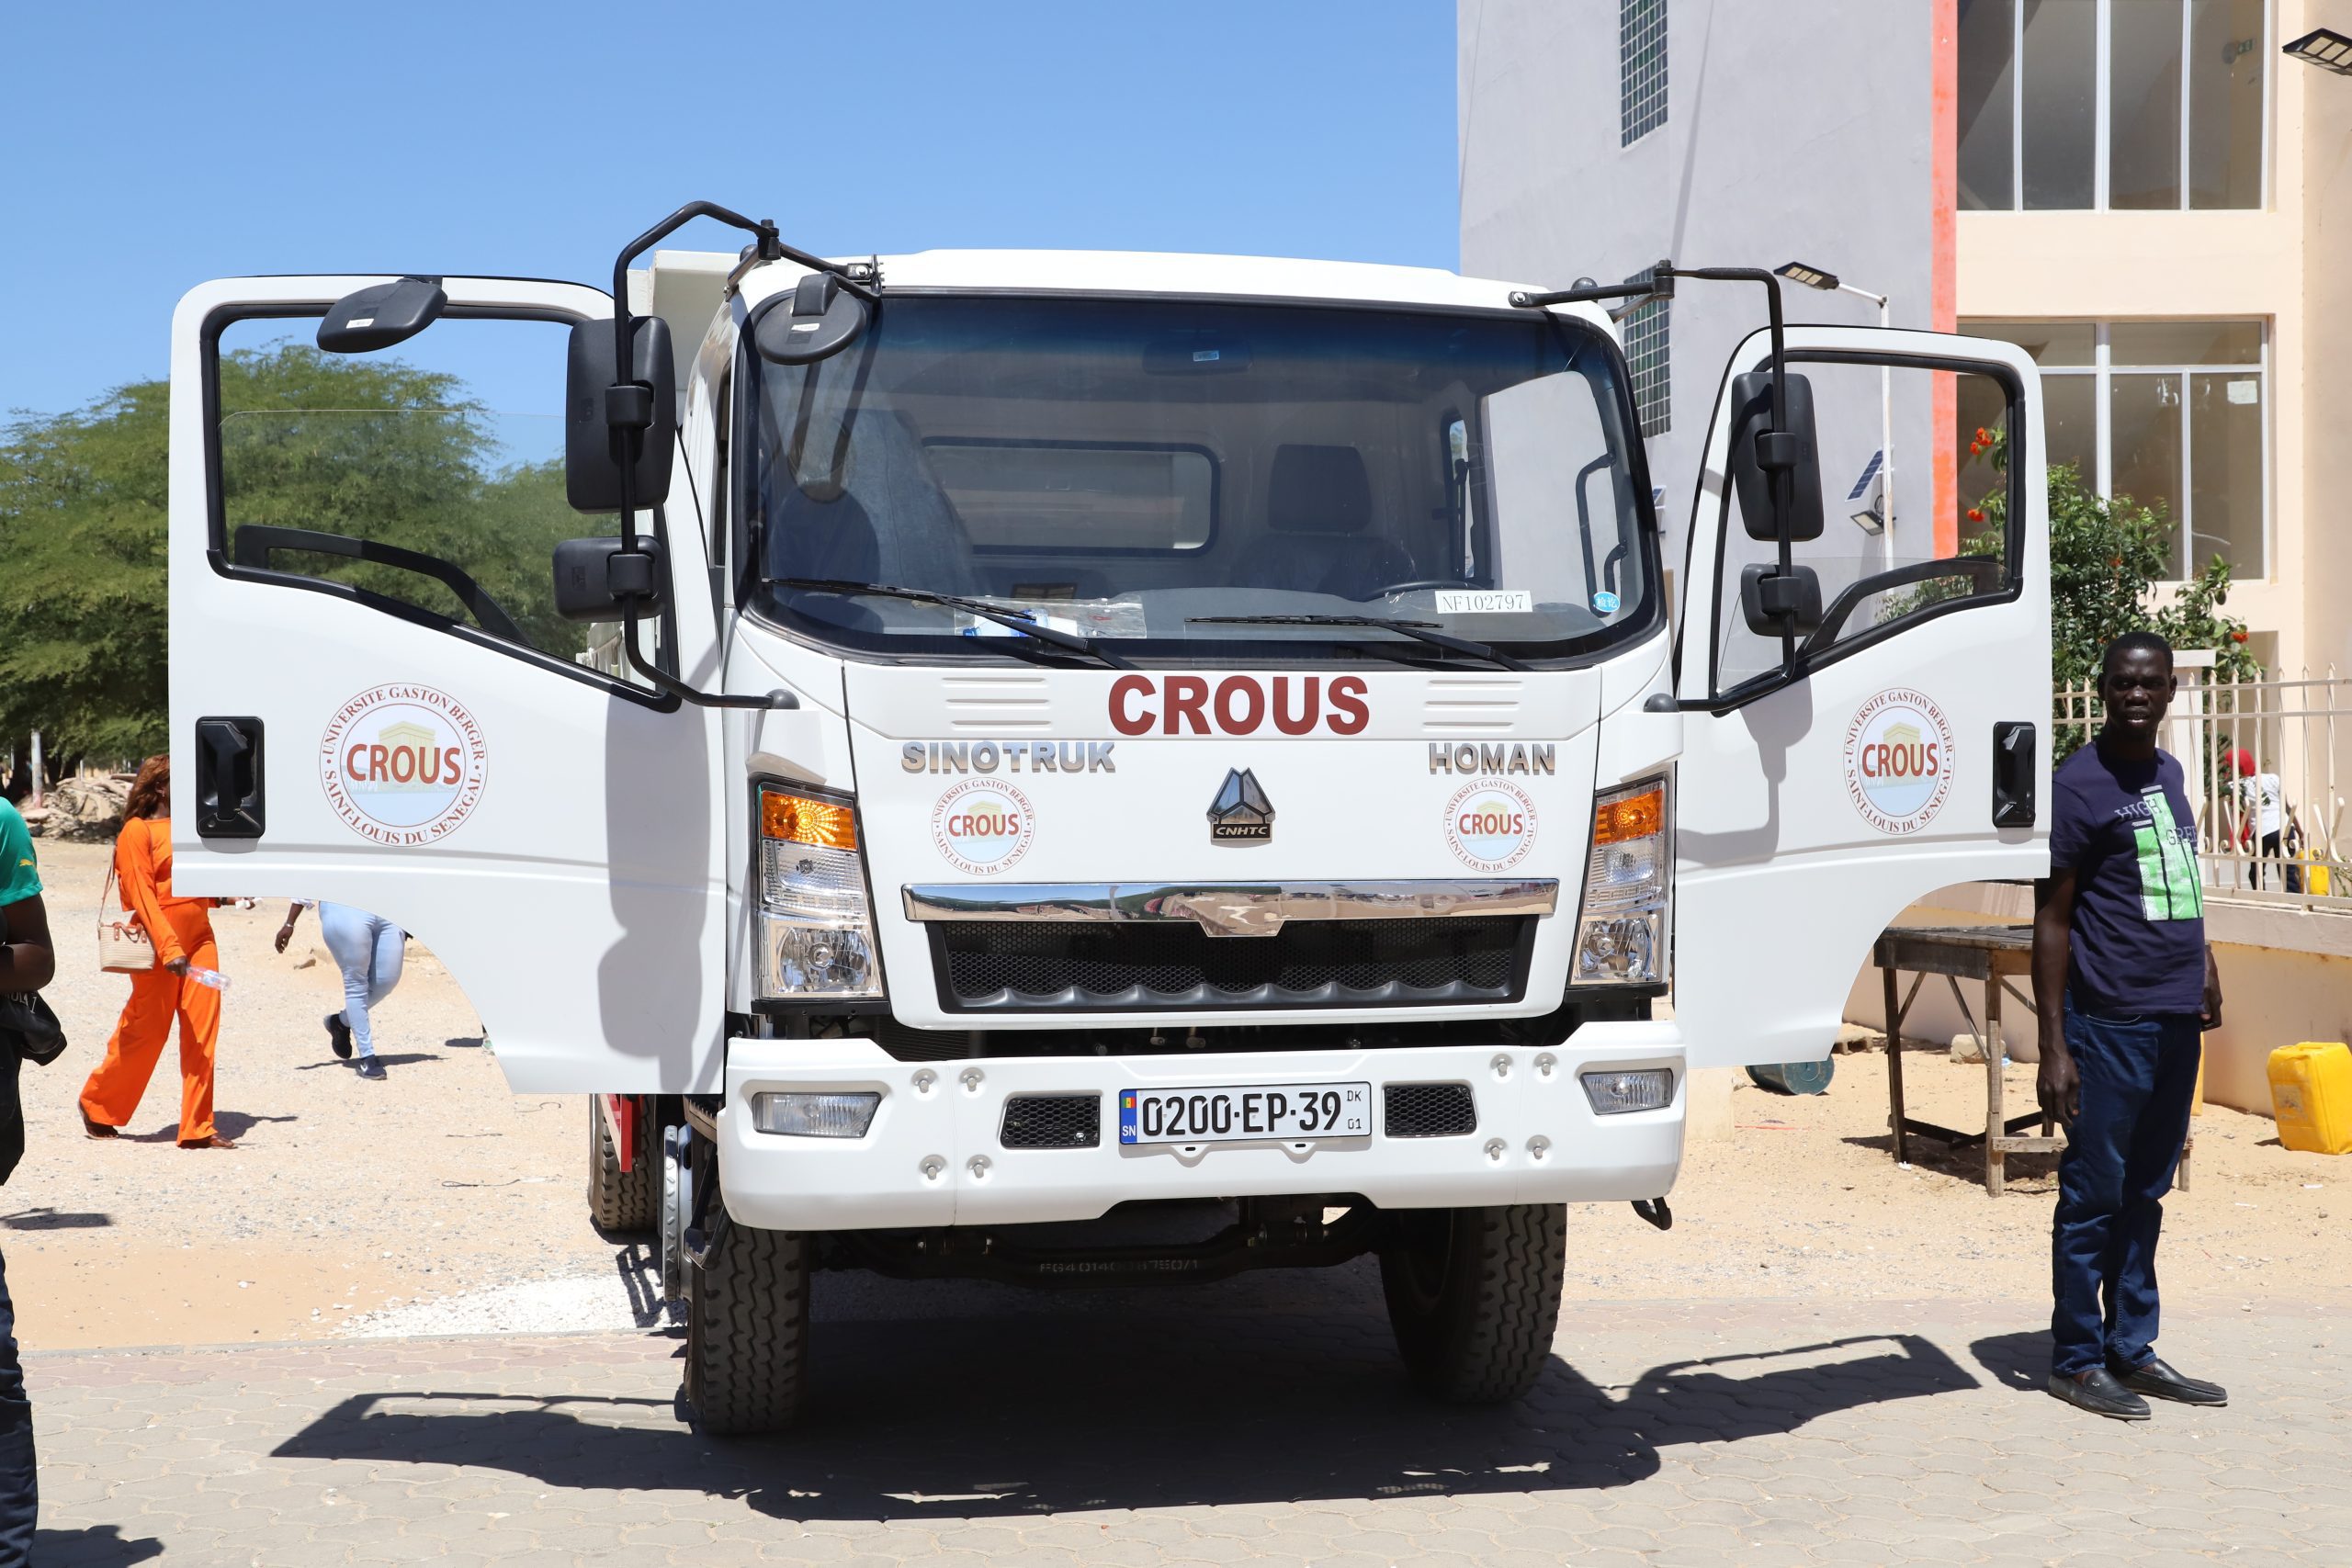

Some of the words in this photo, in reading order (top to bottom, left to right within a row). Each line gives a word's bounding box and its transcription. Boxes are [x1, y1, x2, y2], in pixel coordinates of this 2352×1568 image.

[1442, 593, 1524, 612] NF102797
[322, 688, 386, 755] UNIVERSITE
[389, 686, 450, 710] GASTON
[447, 705, 485, 761] BERGER
[1108, 674, 1370, 736] CROUS
[1845, 694, 1887, 756] UNIVERSITE
[1888, 691, 1929, 710] GASTON
[1928, 705, 1955, 754] BERGER
[346, 743, 461, 784] CROUS
[901, 740, 1116, 773] SINOTRUK
[1429, 742, 1555, 774] HOMAN
[1861, 743, 1939, 778] CROUS
[324, 770, 401, 845] SAINT-LOUIS
[404, 829, 429, 845] DU
[430, 773, 481, 839] SENEGAL
[933, 781, 971, 824] UNIVERSITE
[972, 779, 1010, 792] GASTON
[1010, 788, 1034, 821] BERGER
[1445, 782, 1481, 822] UNIVERSITE
[1481, 780, 1515, 793] GASTON
[1514, 789, 1536, 821] BERGER
[1847, 769, 1900, 833] SAINT-LOUIS
[1902, 818, 1919, 832] DU
[1918, 764, 1951, 825] SENEGAL
[2114, 798, 2163, 822] HIGH
[948, 813, 1020, 837] CROUS
[1216, 826, 1268, 836] CNHTC
[1458, 813, 1523, 835] CROUS
[934, 831, 985, 874] SAINT-LOUIS
[987, 863, 1002, 874] DU
[1001, 826, 1033, 869] SENEGAL
[1446, 828, 1491, 871] SAINT-LOUIS
[1492, 861, 1508, 871] DU
[1507, 826, 1535, 866] SENEGAL
[1347, 1089, 1362, 1102] DK
[1122, 1125, 1136, 1137] SN
